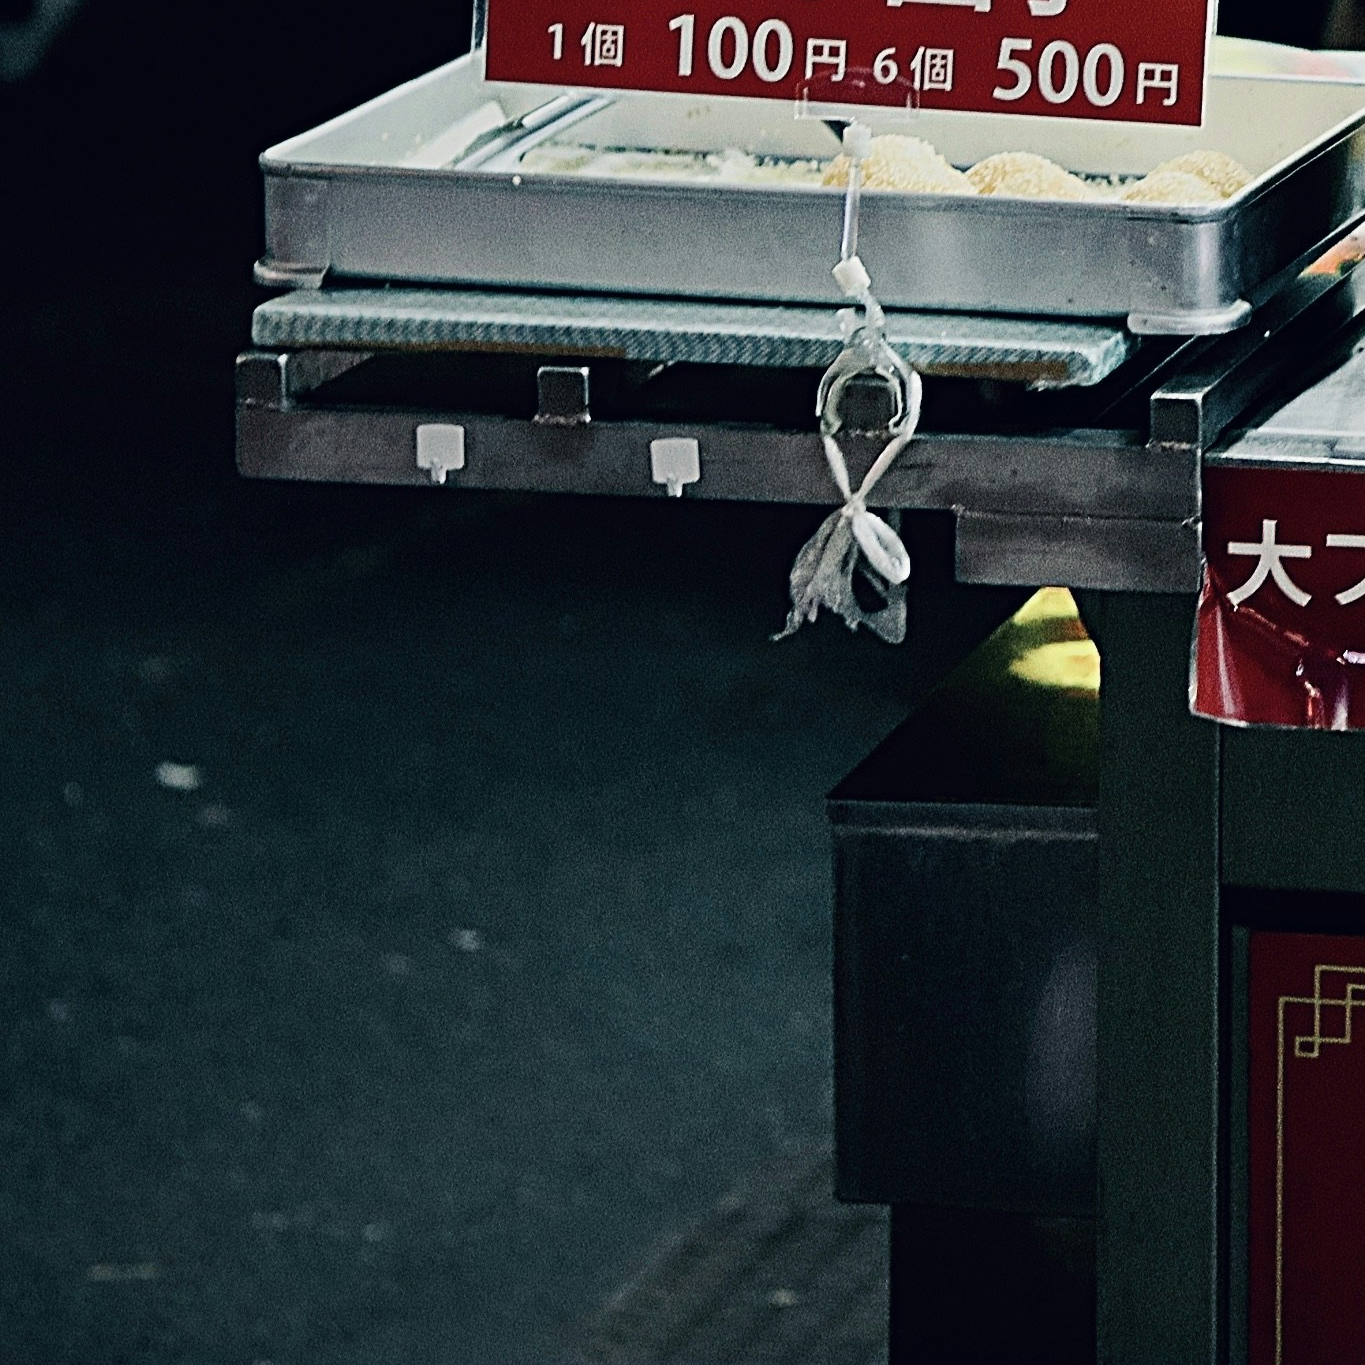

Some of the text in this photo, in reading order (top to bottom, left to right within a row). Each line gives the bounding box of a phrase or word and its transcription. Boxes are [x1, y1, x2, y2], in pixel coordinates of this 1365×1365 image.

[547, 14, 1179, 107] 1個 100円 6個 500円
